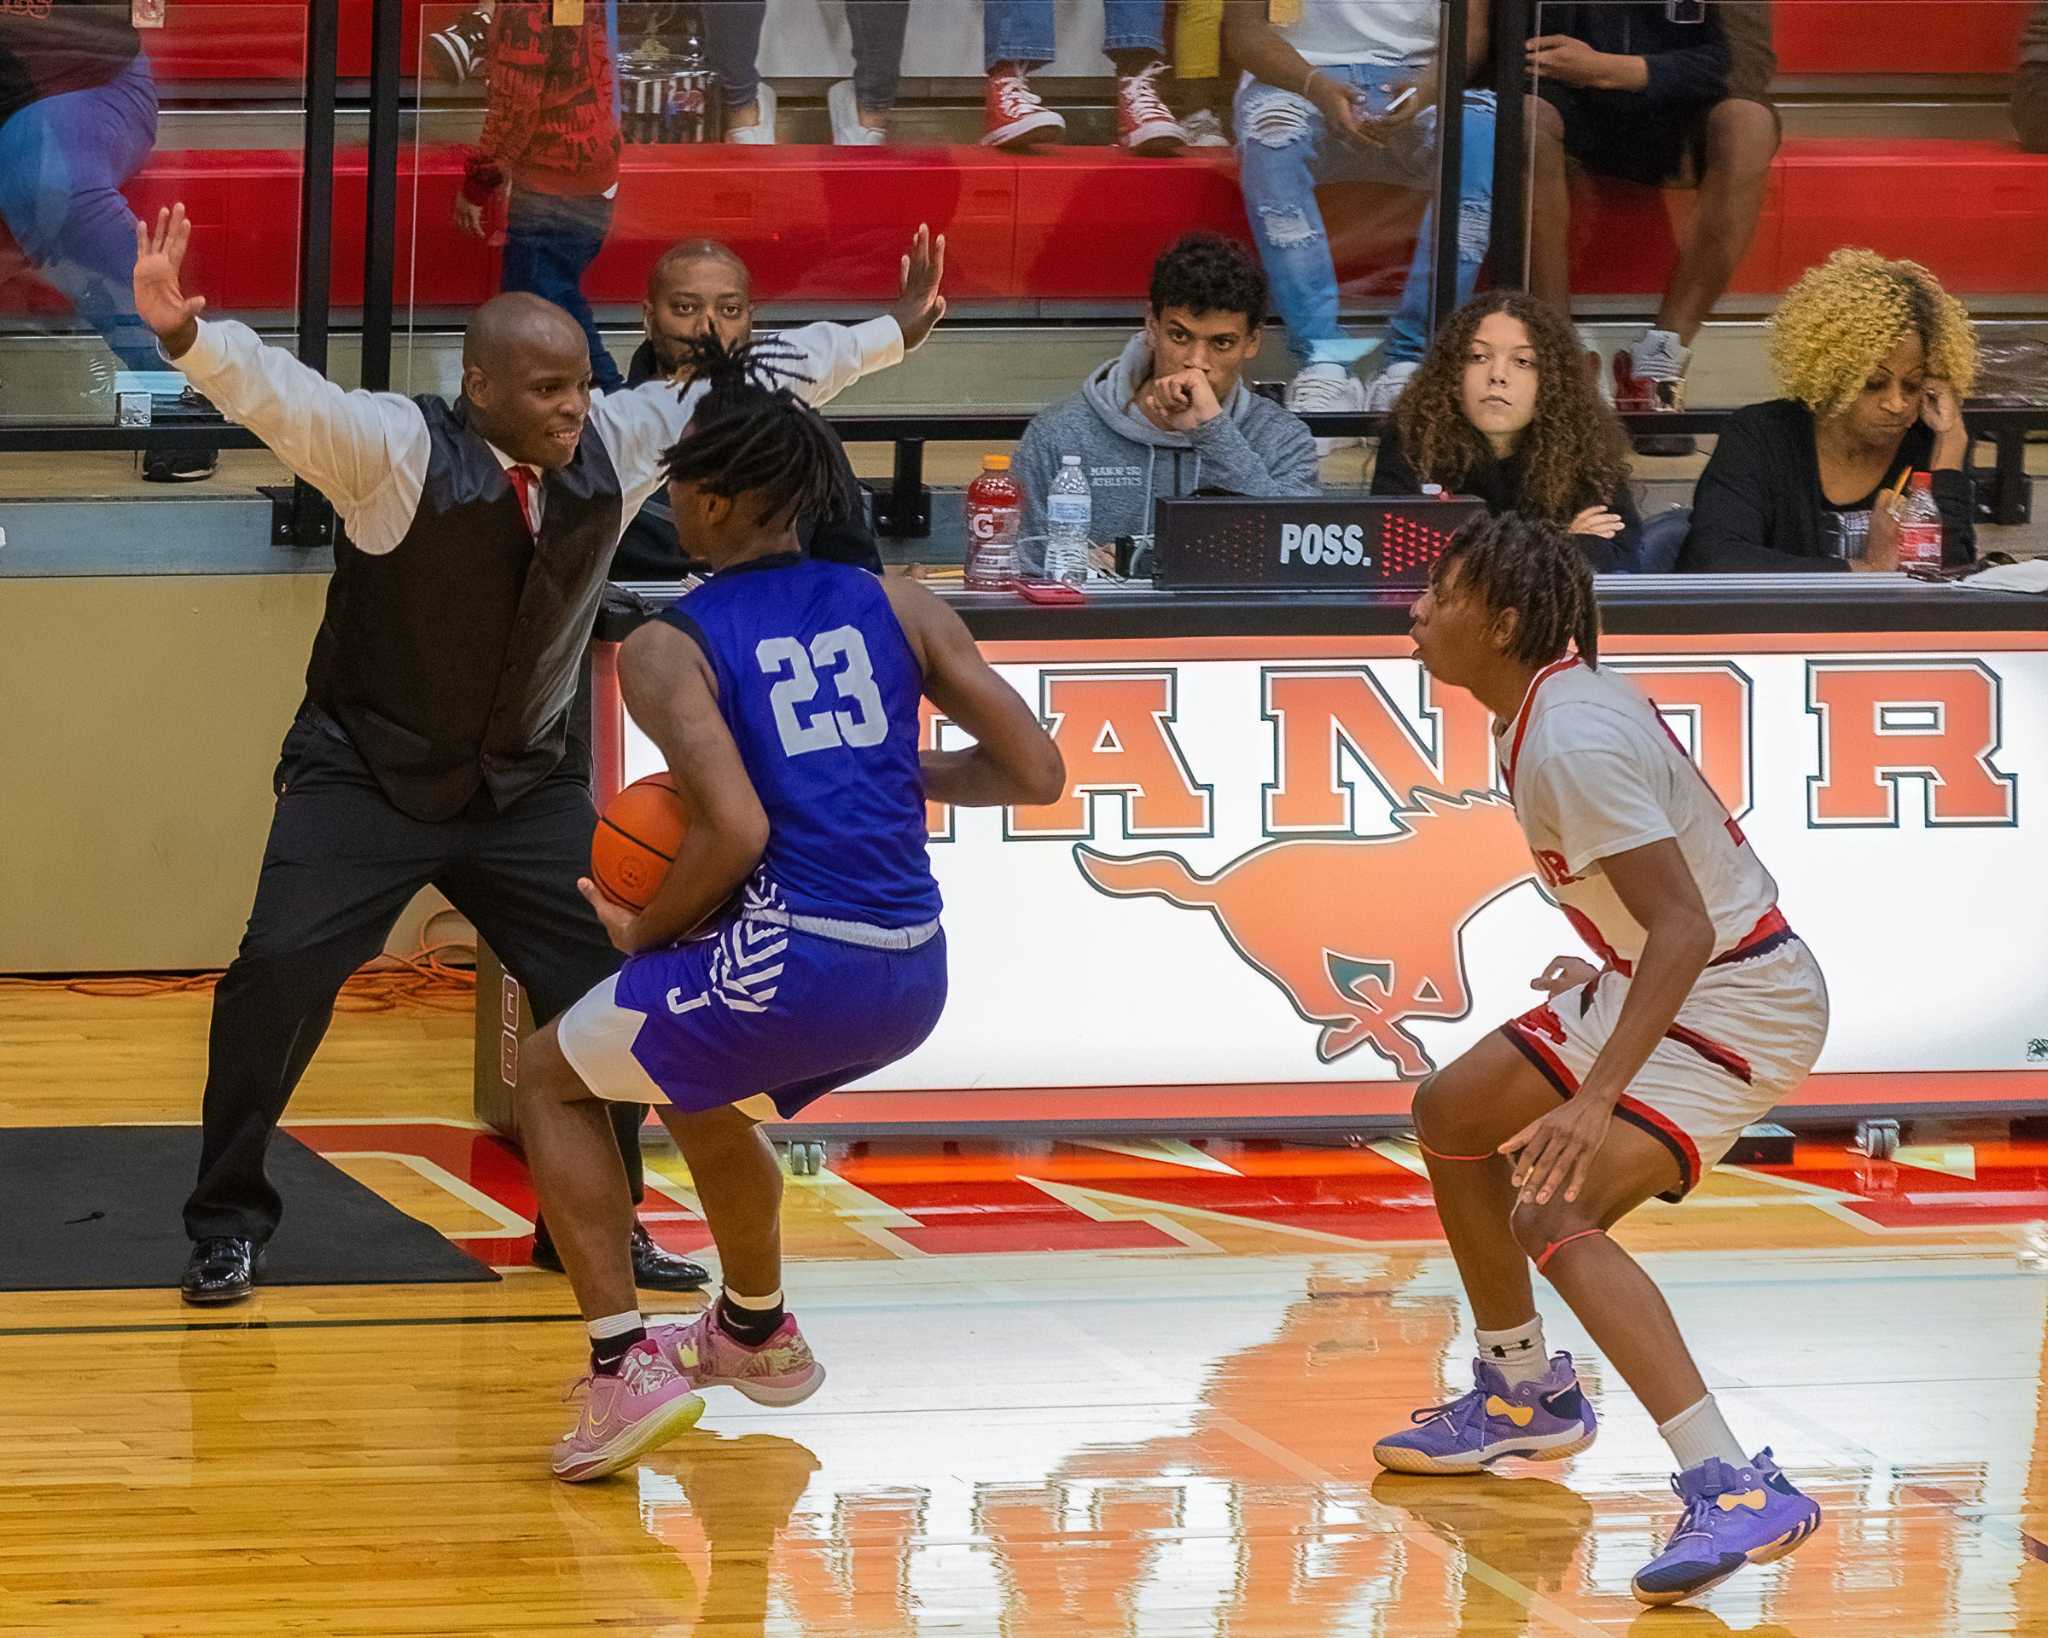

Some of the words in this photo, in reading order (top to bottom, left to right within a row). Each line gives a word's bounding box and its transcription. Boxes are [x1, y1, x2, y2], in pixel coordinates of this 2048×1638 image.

[972, 513, 995, 540] G
[1279, 523, 1372, 567] POSS.
[755, 624, 889, 757] 23
[918, 657, 2019, 843] ANR
